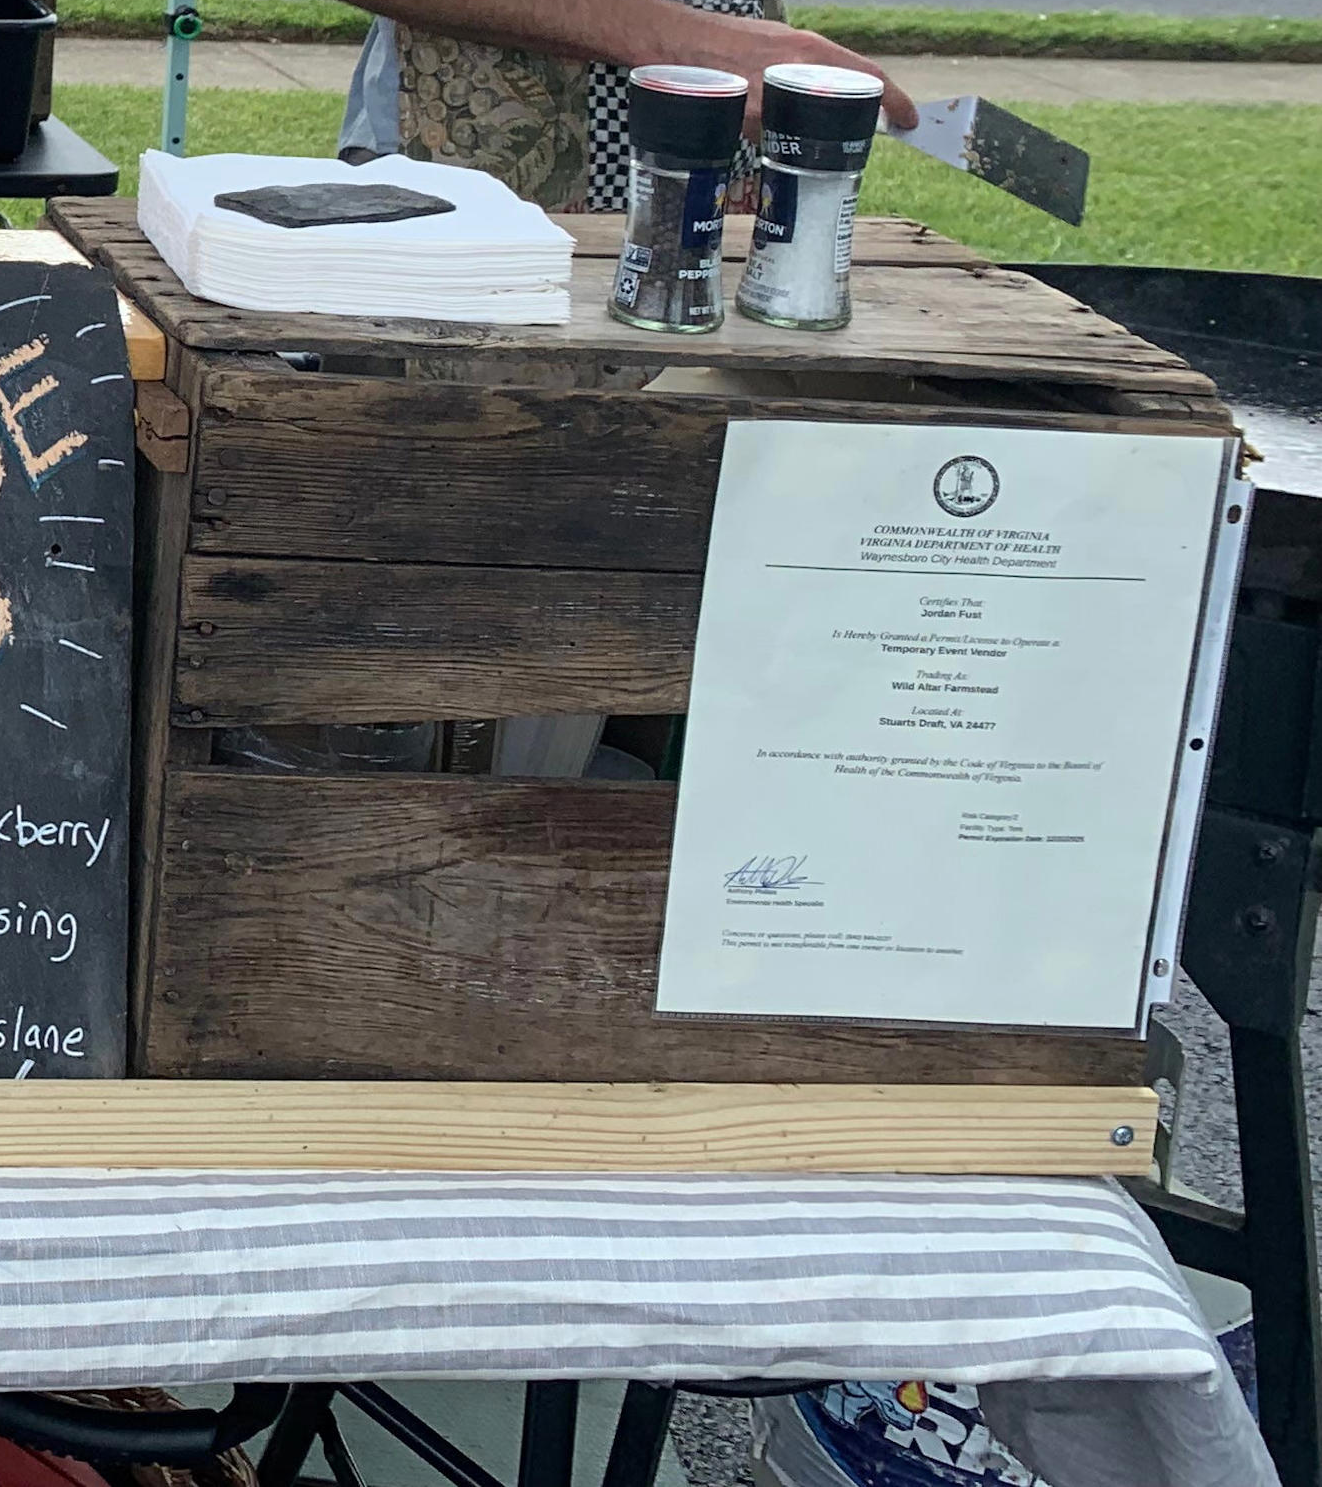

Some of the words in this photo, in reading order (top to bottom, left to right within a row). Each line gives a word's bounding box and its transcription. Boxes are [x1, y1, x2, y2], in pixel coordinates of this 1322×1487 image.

[874, 524, 975, 538] COMMONWEALTH
[977, 529, 995, 539] OF
[996, 530, 1050, 541] VIRGINIA
[860, 537, 912, 548] VIRGINIA
[914, 539, 994, 551] DEPARTMENT
[994, 542, 1012, 552] OF
[1013, 544, 1062, 554] HEALTH
[861, 551, 928, 563] Waynesboro
[931, 554, 952, 566] City
[955, 556, 990, 566] Health
[992, 556, 1058, 569] Department
[919, 596, 958, 608] Certifies
[921, 609, 956, 619] Jordan
[958, 609, 982, 620] Fust
[832, 629, 841, 639] Is
[844, 630, 876, 642] Hereby
[880, 631, 920, 642] Granted
[920, 634, 927, 642] a
[881, 643, 937, 656] Temporary
[938, 646, 968, 656] Event
[971, 647, 1007, 658] Vendor
[916, 669, 952, 681] Trading
[892, 681, 915, 691] Wild
[917, 682, 941, 692] Altar
[944, 683, 998, 695] Farmstead
[911, 706, 948, 716] Located
[879, 716, 916, 727] Stuarts
[919, 719, 947, 729] Draft,
[949, 720, 964, 729] VA
[965, 721, 996, 730] 24477
[757, 748, 767, 758] In
[768, 750, 821, 759] accordance
[824, 752, 844, 760] with
[845, 753, 888, 764] authority
[929, 757, 940, 767] by
[834, 764, 867, 775] Health
[868, 766, 881, 777] of
[881, 768, 896, 777] the
